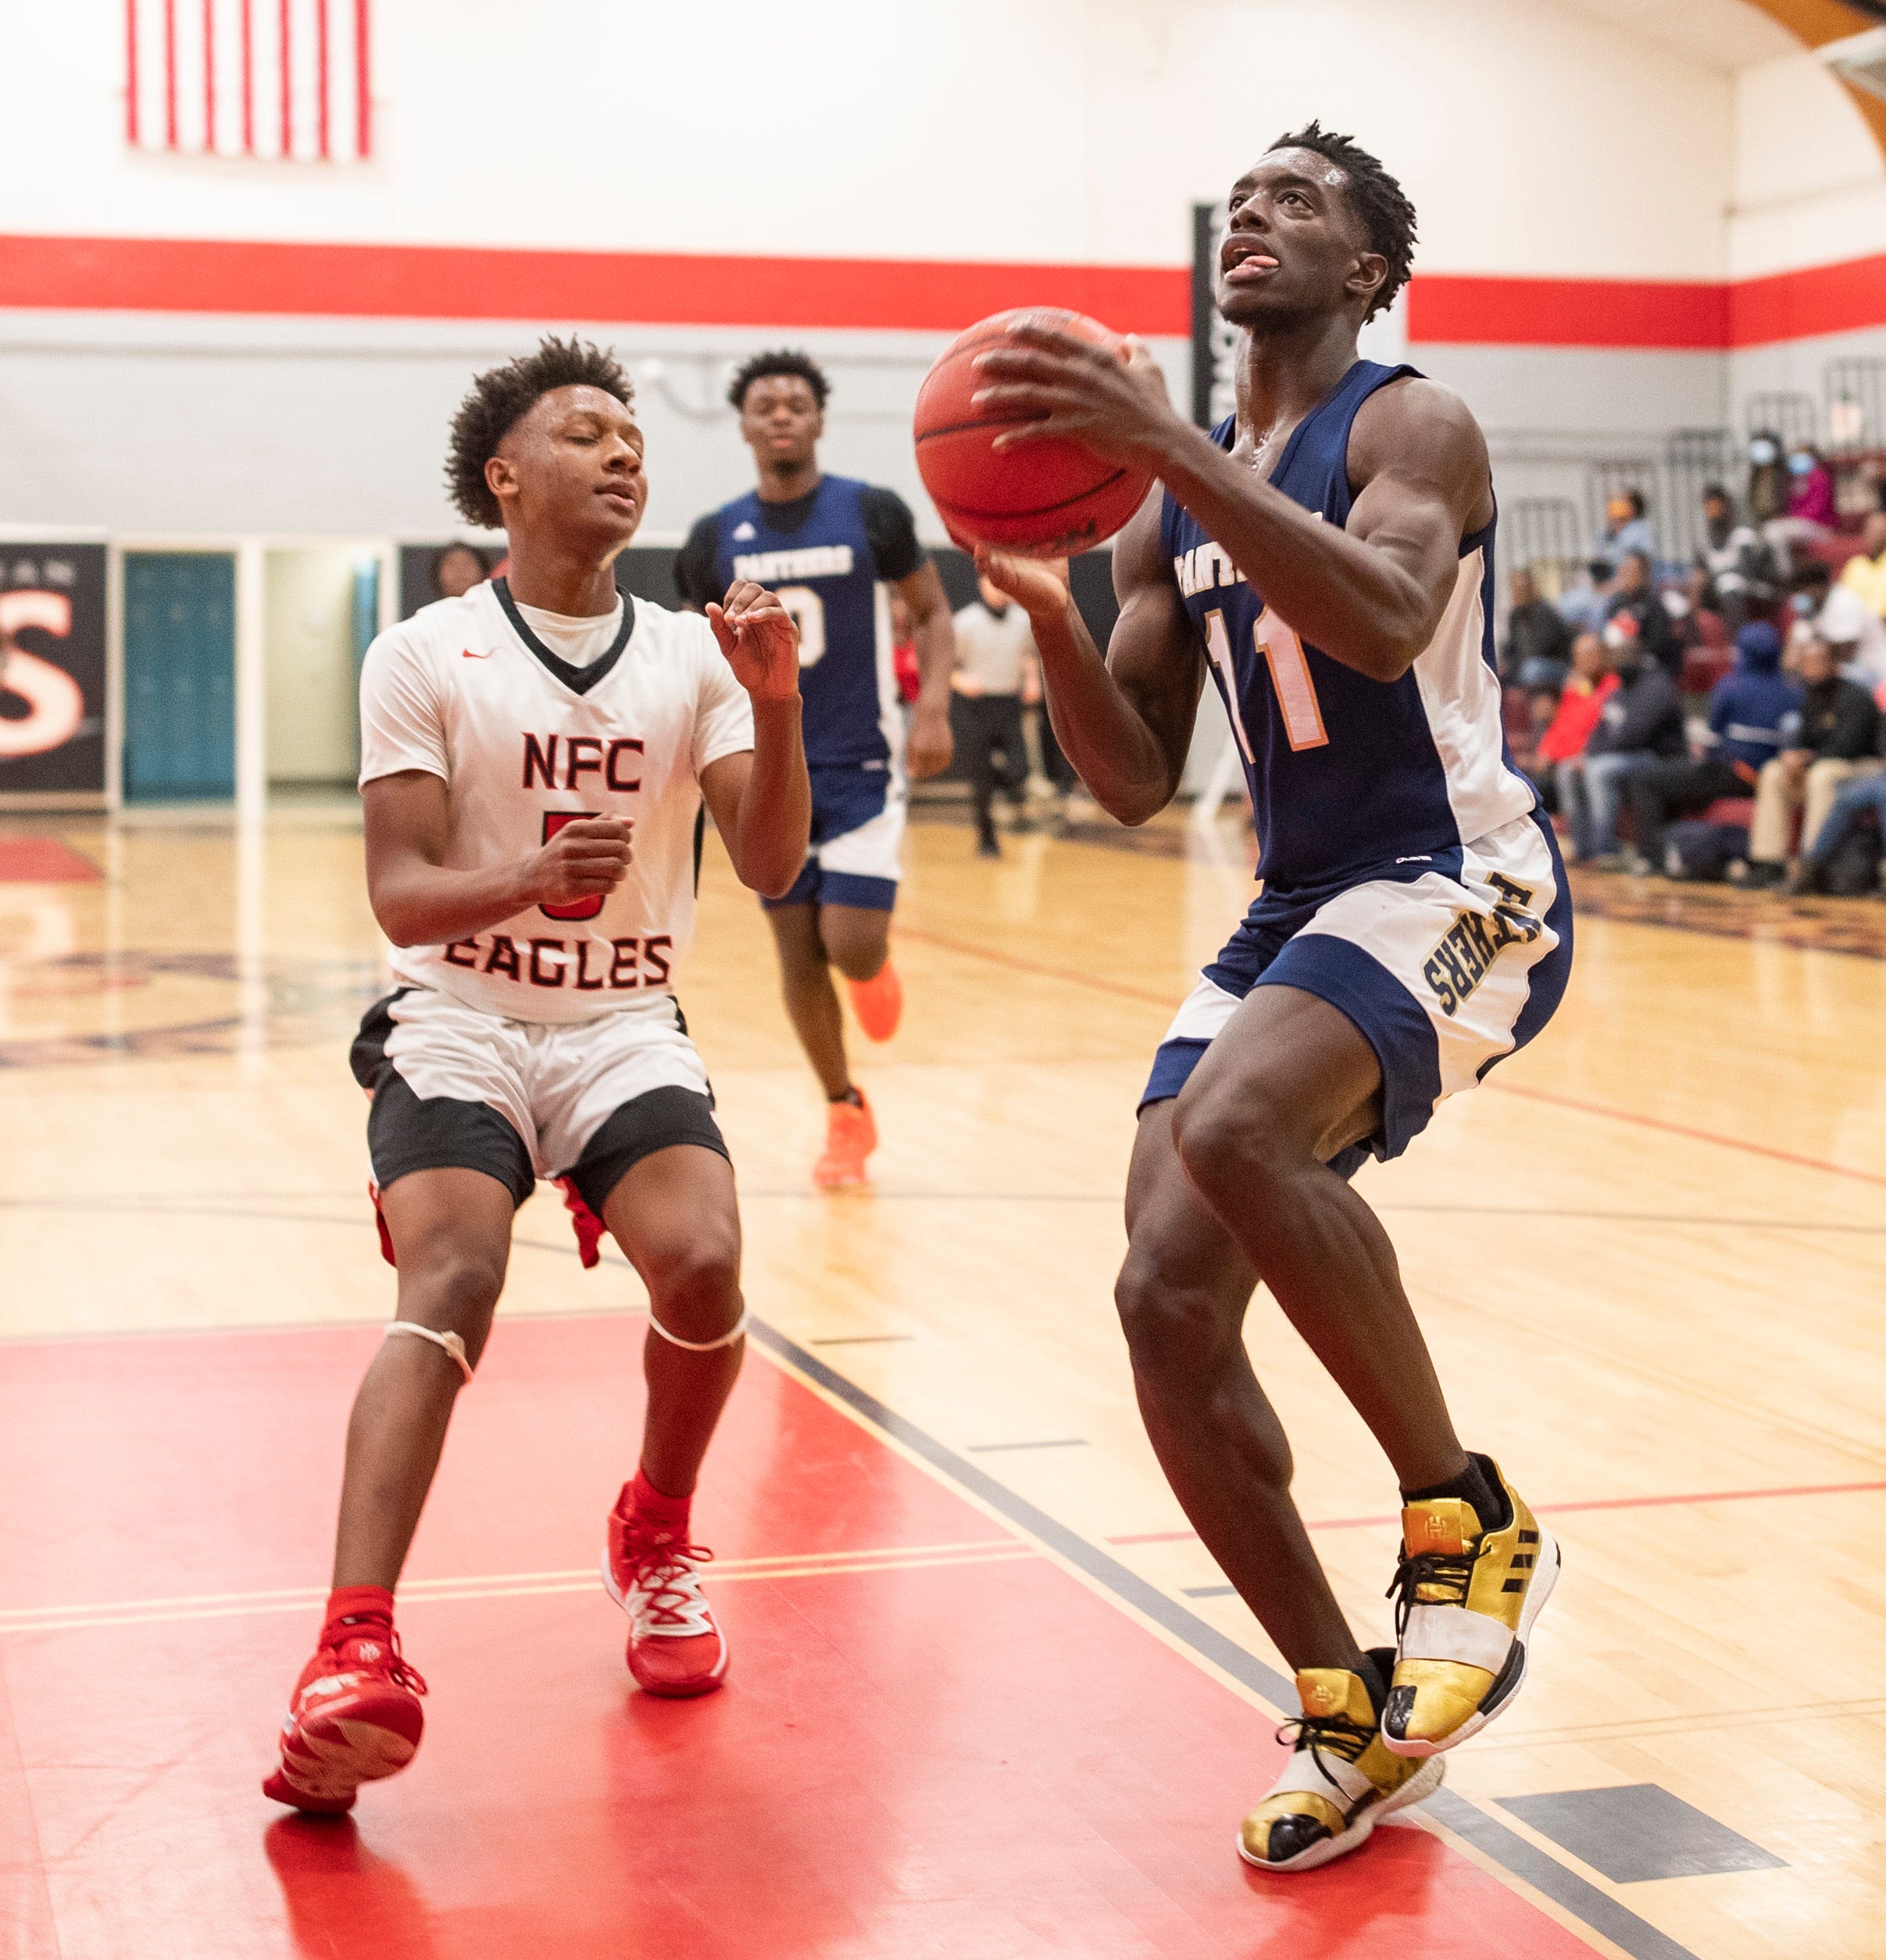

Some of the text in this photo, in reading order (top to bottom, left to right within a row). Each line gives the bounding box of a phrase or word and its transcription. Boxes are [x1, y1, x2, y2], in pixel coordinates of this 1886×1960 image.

[1204, 607, 1329, 765] 11
[521, 731, 645, 792] NFC
[441, 934, 673, 991] EAGLES
